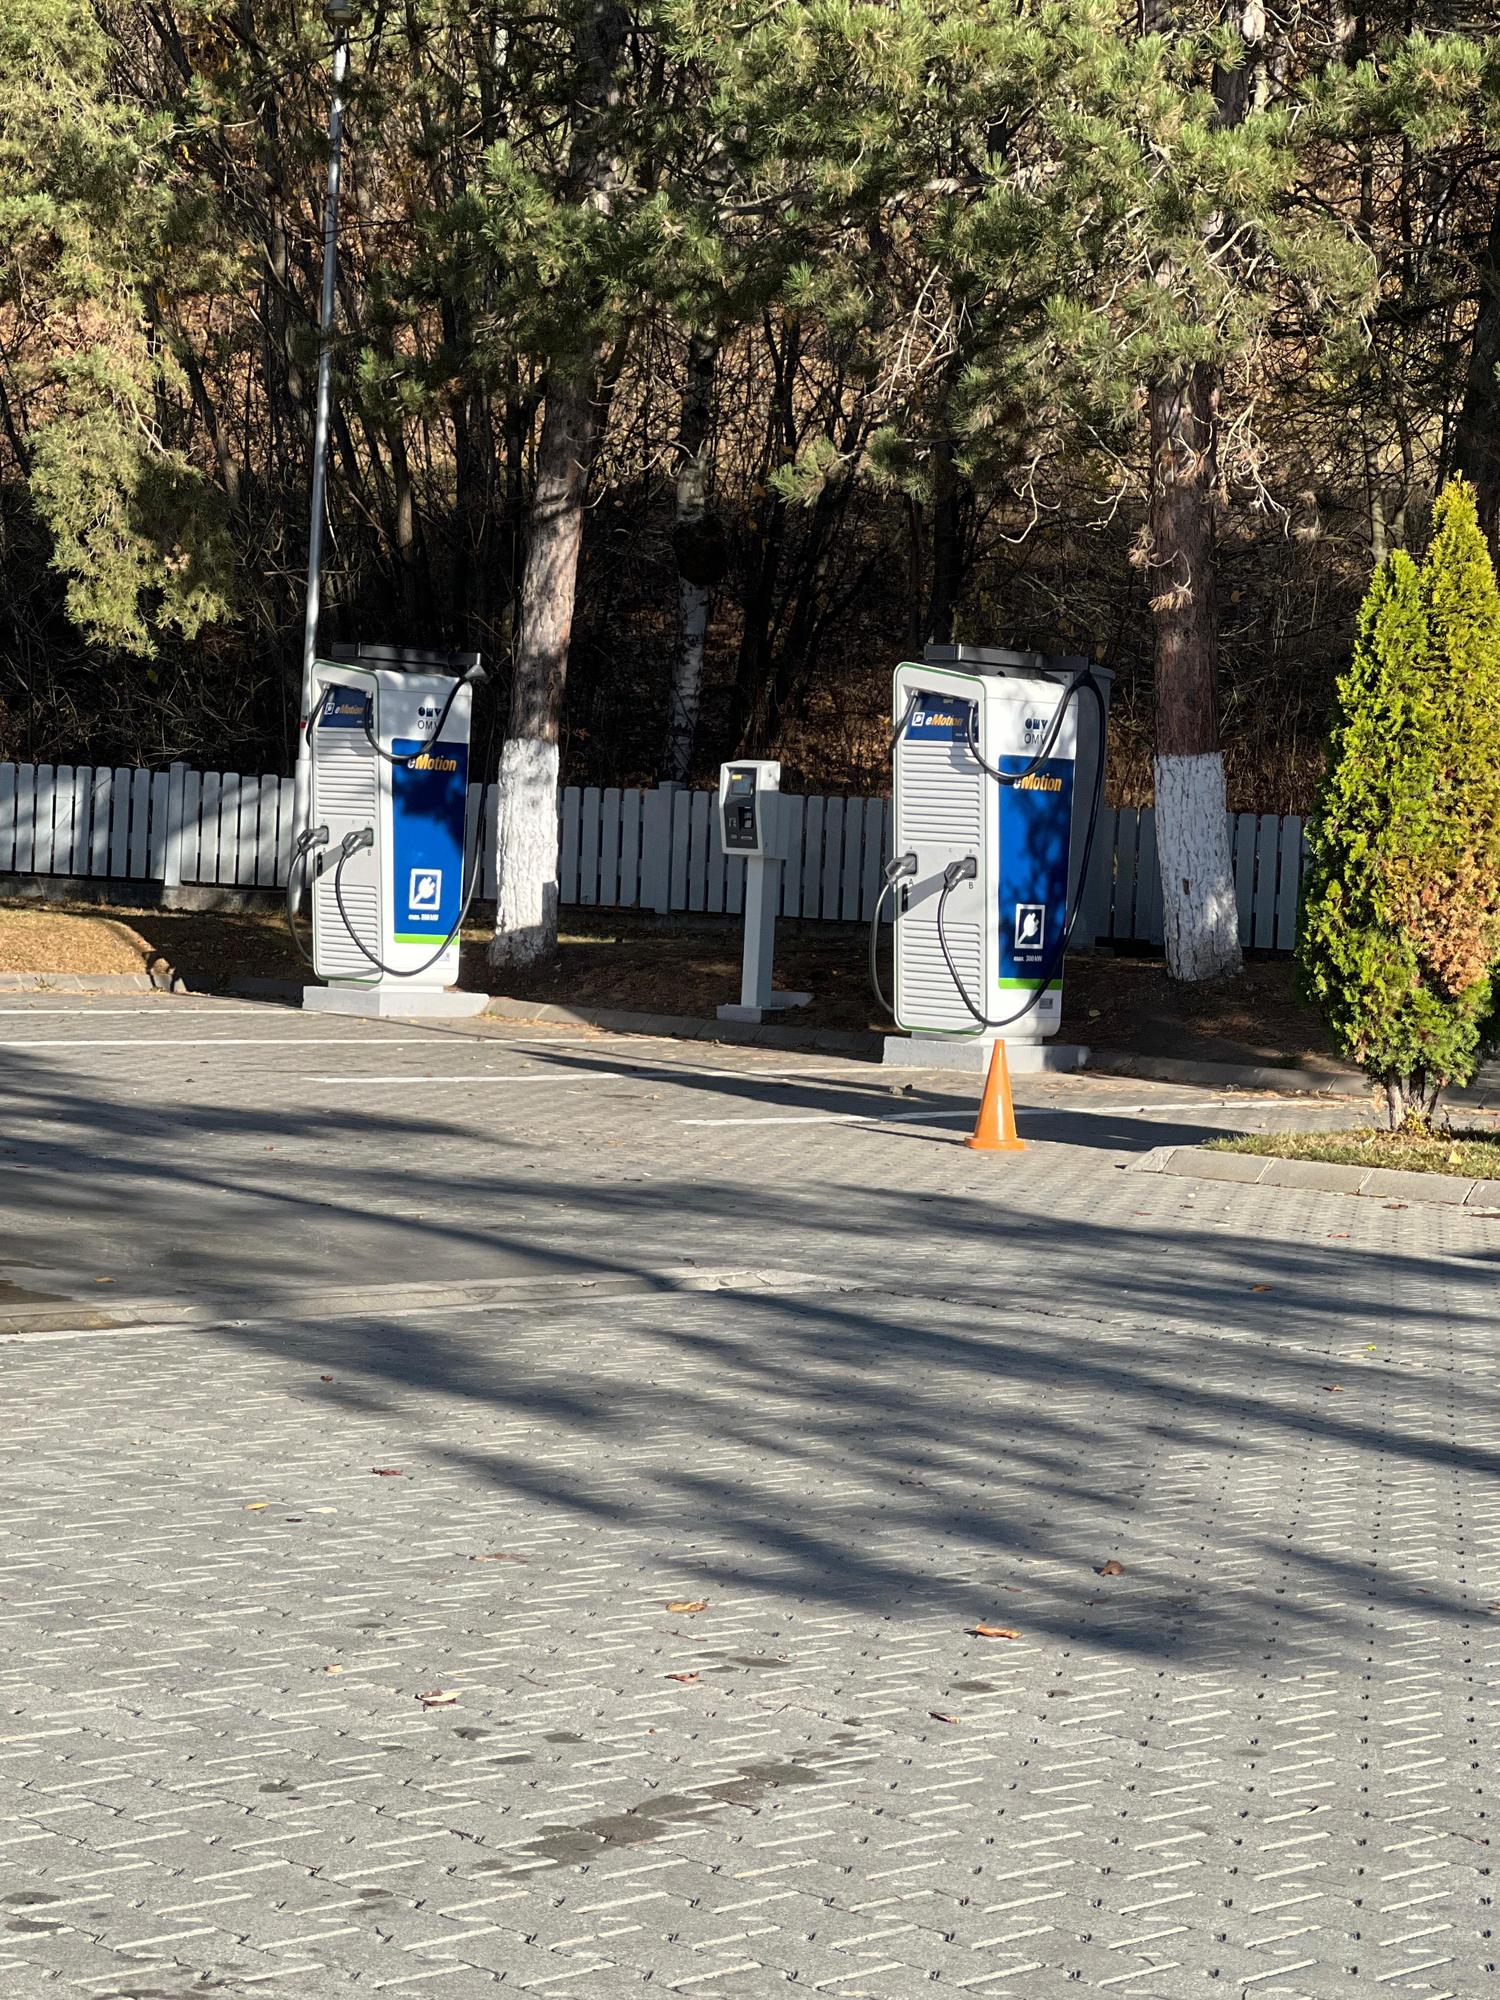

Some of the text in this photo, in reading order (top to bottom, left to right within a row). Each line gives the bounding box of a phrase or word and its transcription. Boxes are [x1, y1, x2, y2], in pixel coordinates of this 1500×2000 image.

[925, 714, 964, 726] eMotion
[407, 753, 457, 772] eMotion
[968, 881, 974, 890] B
